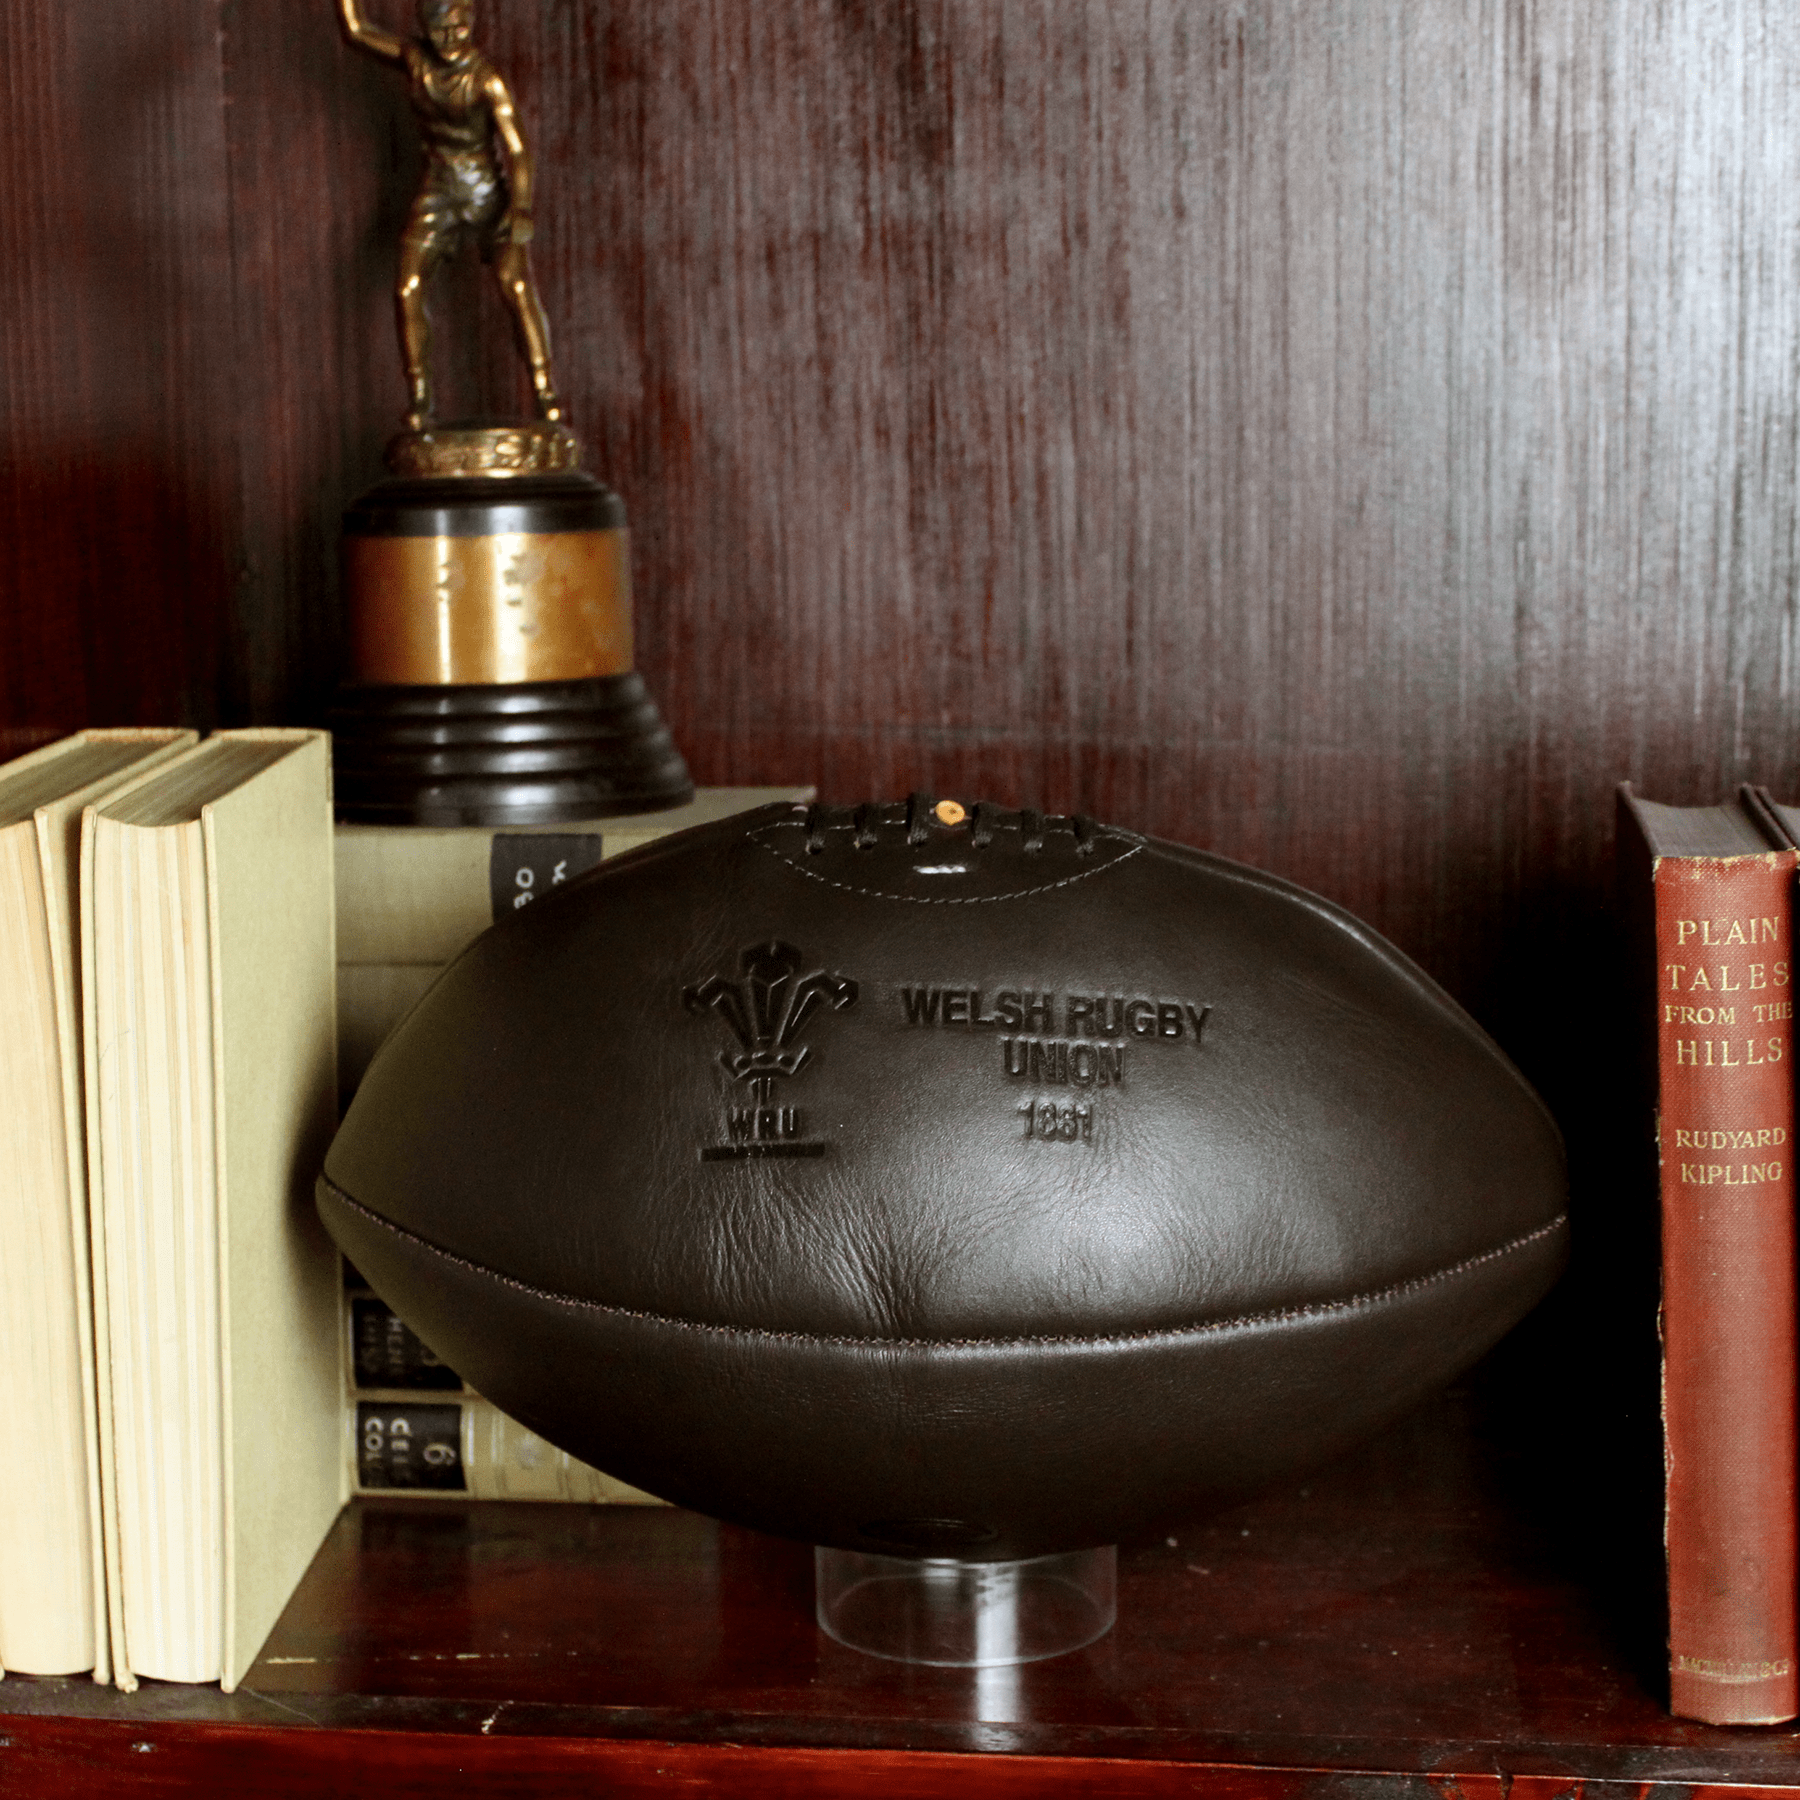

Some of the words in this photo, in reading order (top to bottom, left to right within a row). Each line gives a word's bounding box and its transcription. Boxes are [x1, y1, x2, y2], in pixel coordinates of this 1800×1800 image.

[1676, 916, 1780, 946] PLAIN
[1665, 961, 1790, 992] TALES
[902, 986, 1052, 1035] WELSH
[1068, 994, 1213, 1042] RUGBY
[1664, 1004, 1736, 1025] FROM
[1752, 1001, 1793, 1024] THE
[1003, 1039, 1124, 1088] UNION
[1676, 1037, 1783, 1067] HILLS
[1675, 1127, 1787, 1150] RUDYARD
[1680, 1161, 1783, 1186] KIPLING
